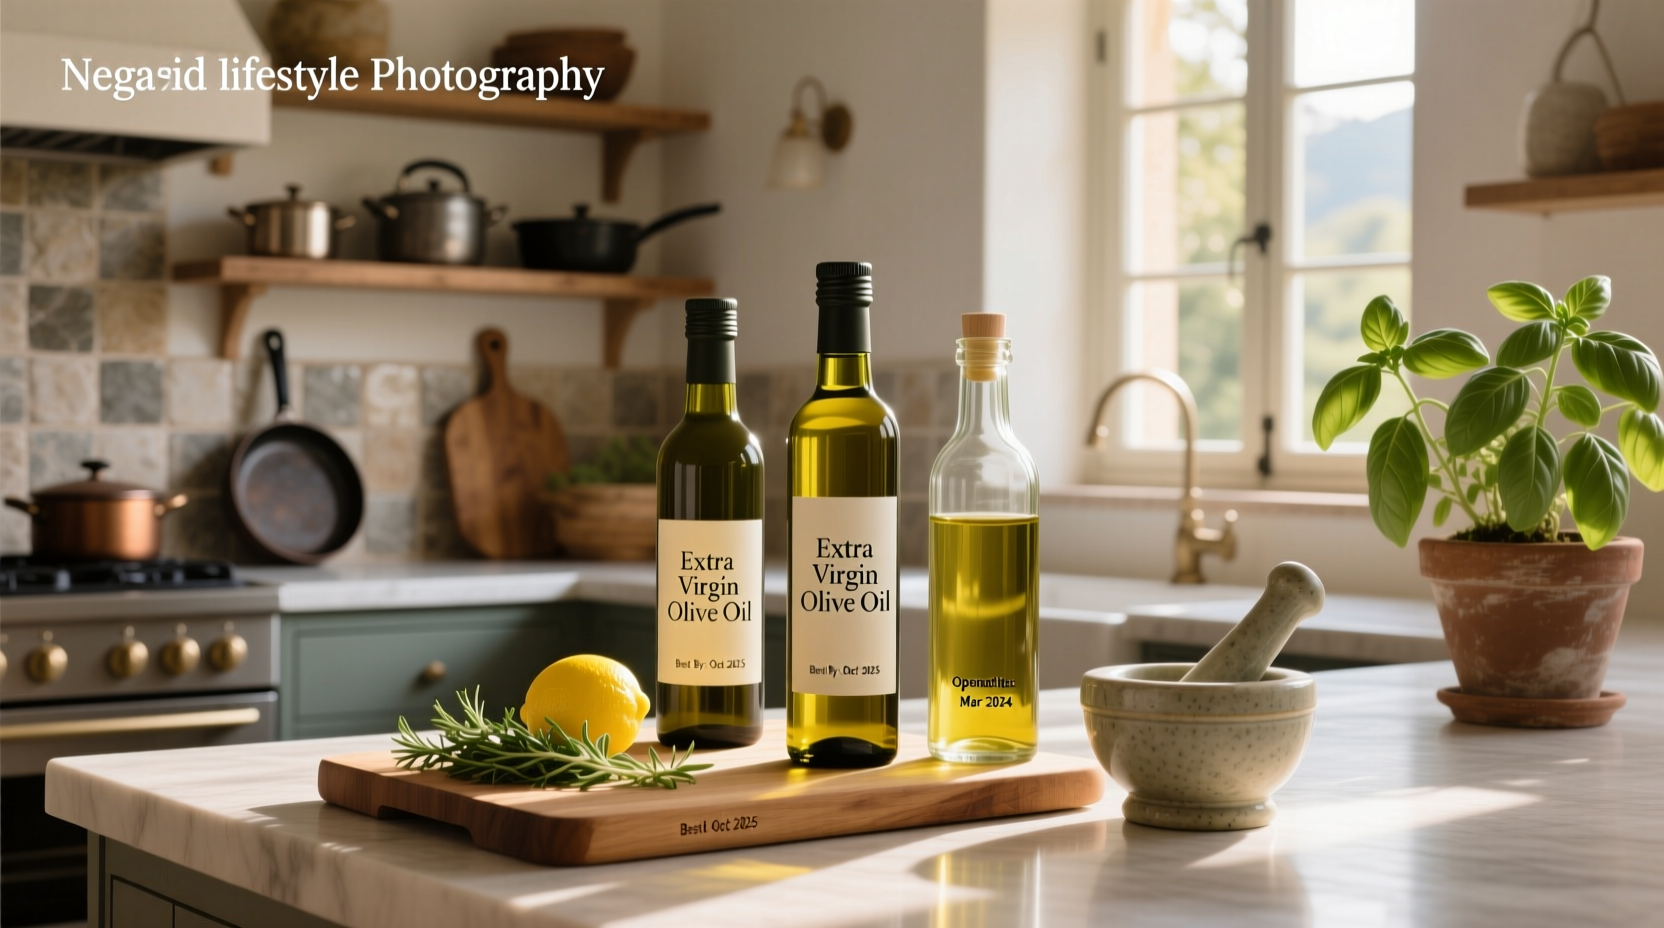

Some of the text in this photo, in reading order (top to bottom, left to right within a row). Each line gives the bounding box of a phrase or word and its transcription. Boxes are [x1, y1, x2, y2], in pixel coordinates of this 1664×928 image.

[816, 538, 873, 558] Extra
[681, 551, 734, 571] Extra
[812, 564, 878, 591] Virgin
[801, 590, 890, 612] Olive Oil
[667, 601, 751, 622] Olive Oil
[960, 695, 983, 707] Mar
[711, 819, 731, 832] Oct
